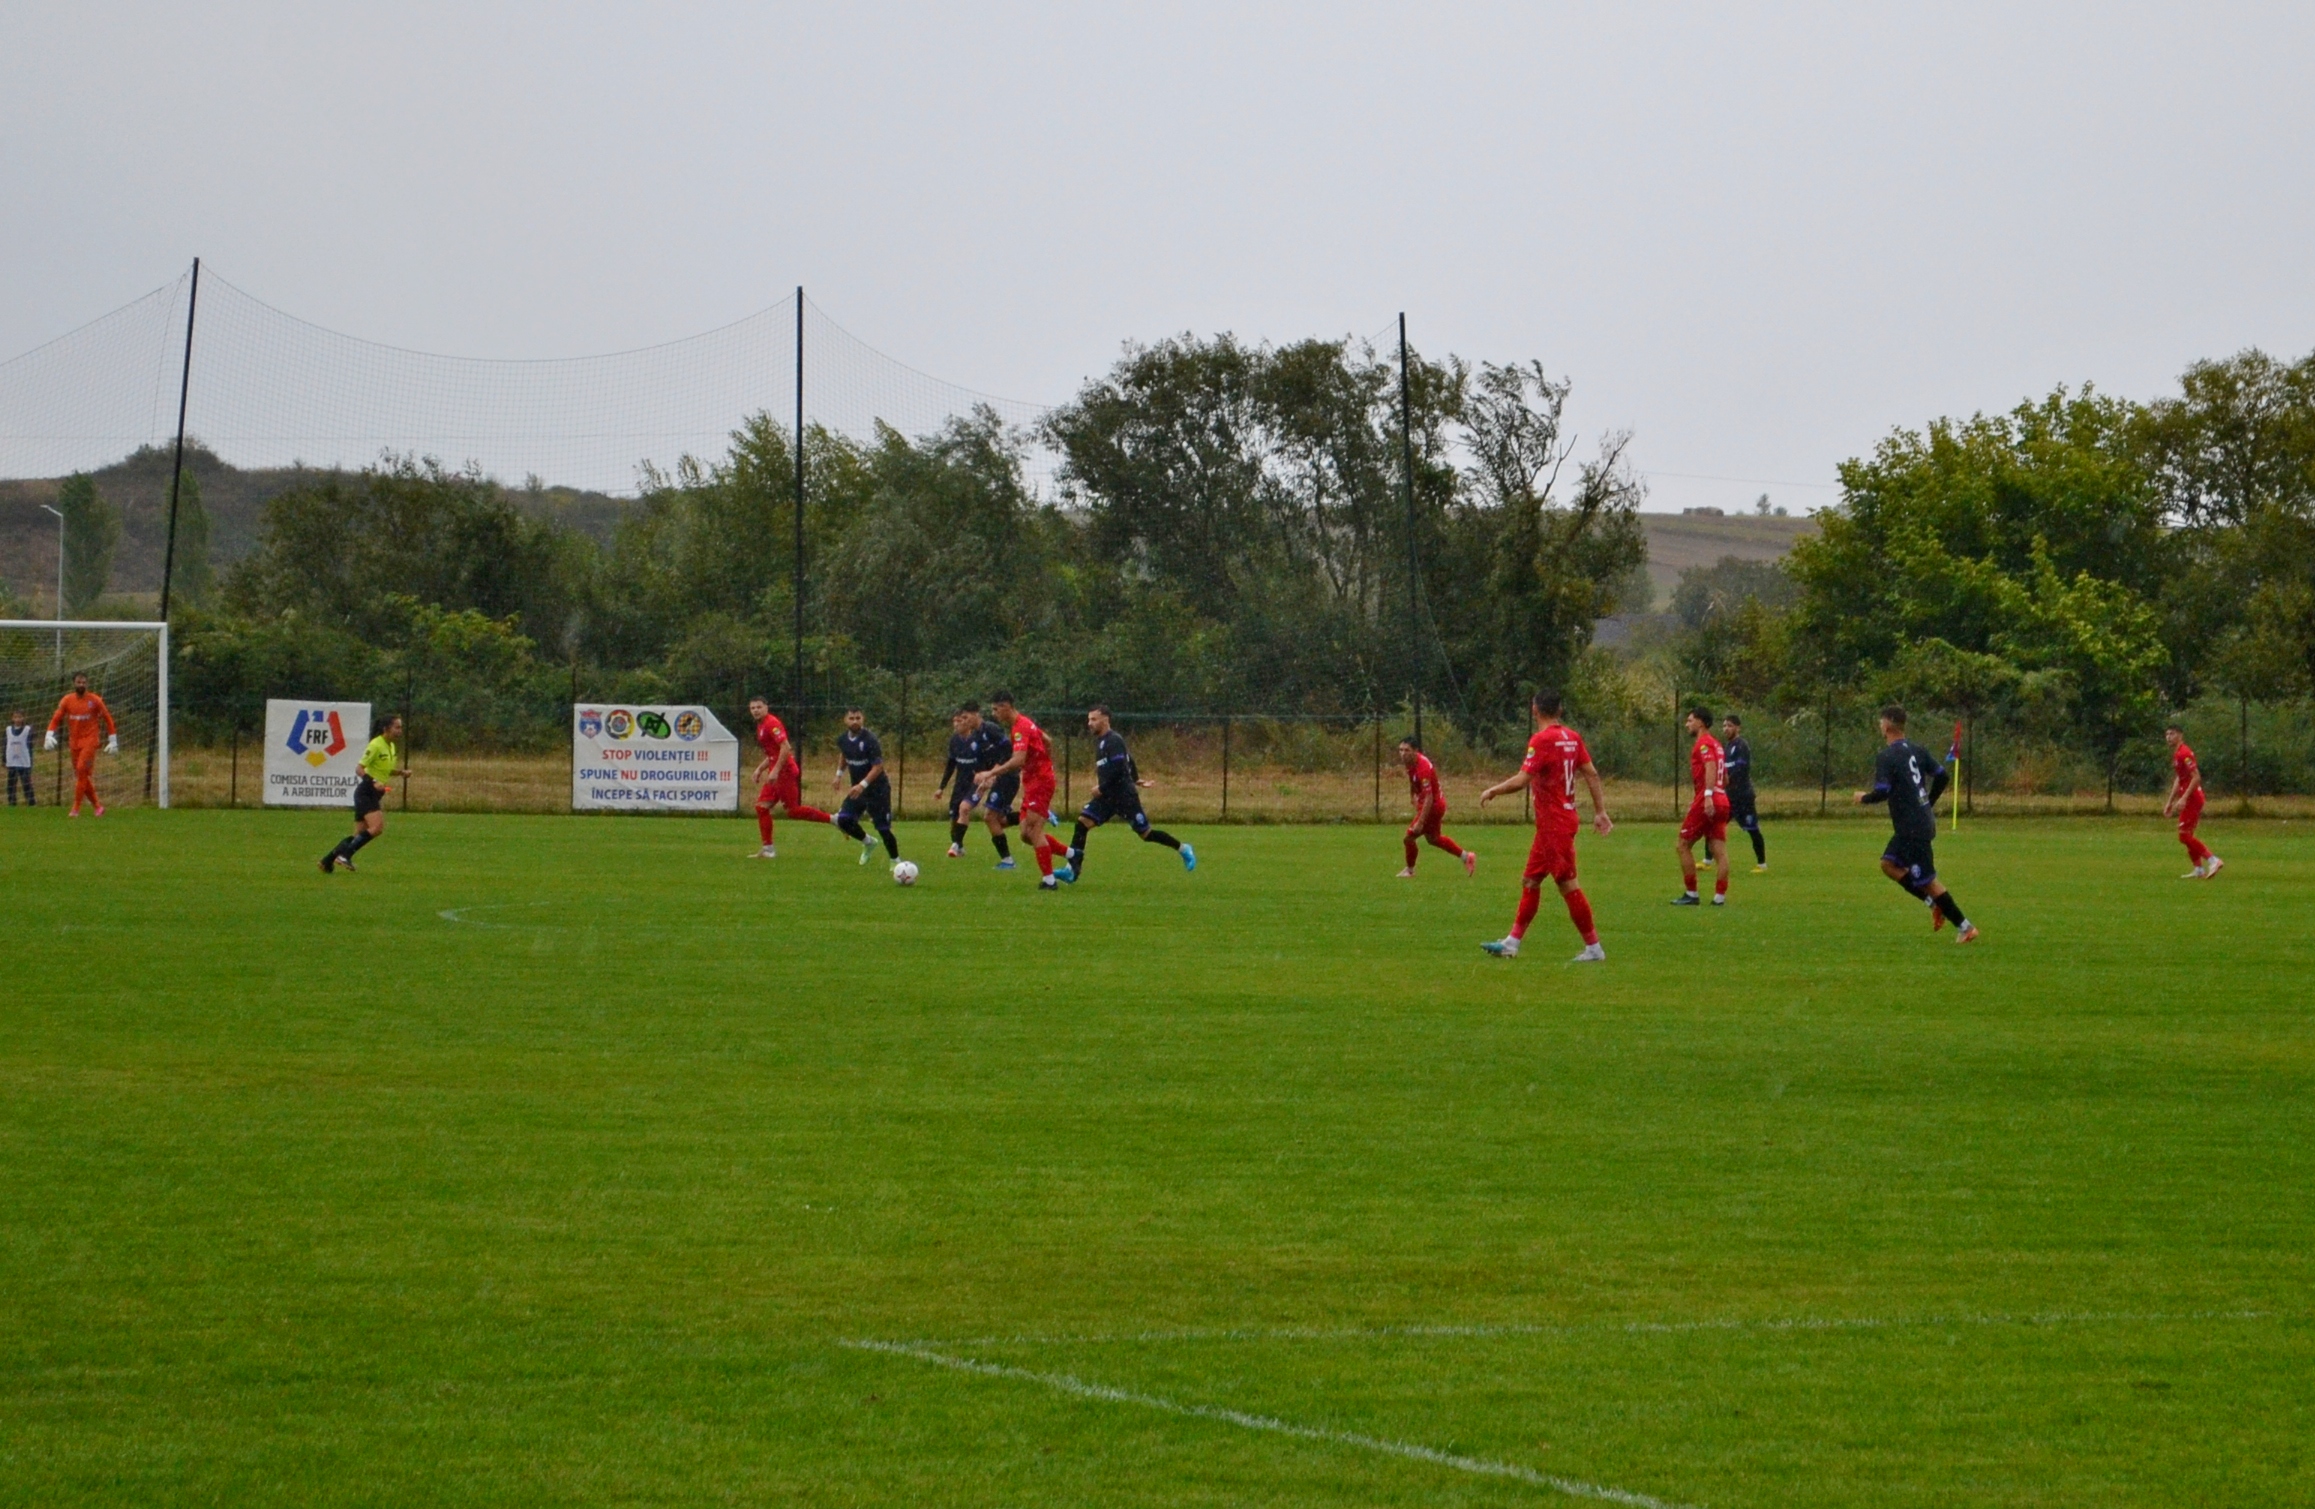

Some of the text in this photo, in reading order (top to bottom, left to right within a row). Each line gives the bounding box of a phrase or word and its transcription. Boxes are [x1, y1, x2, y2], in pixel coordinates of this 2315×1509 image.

[306, 729, 329, 744] FRF
[602, 750, 632, 760] STOP
[697, 751, 708, 761] !!!
[270, 774, 308, 785] COMISIA
[580, 769, 731, 781] SPUNE NU DROGURILOR !!!
[282, 787, 347, 797] A ARBITRILOR
[653, 789, 678, 800] FACI
[680, 790, 718, 801] SPORT
